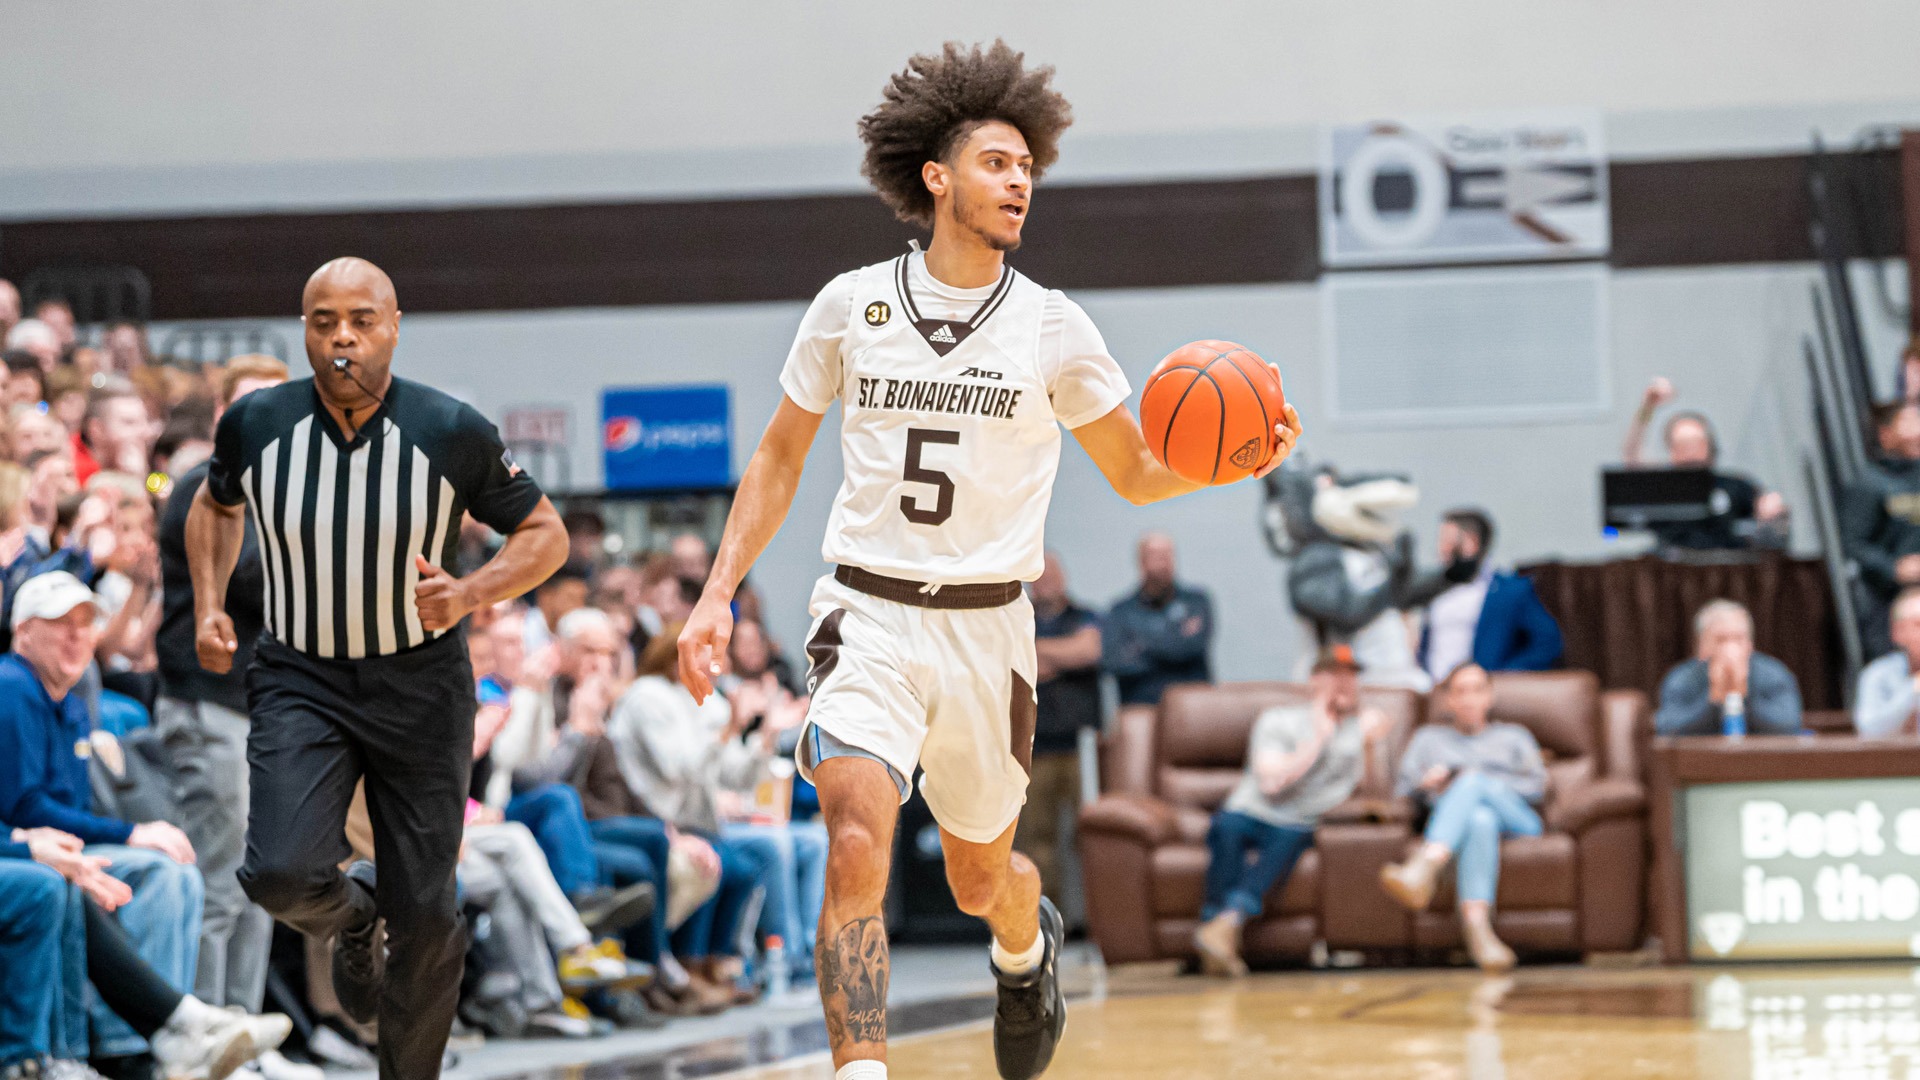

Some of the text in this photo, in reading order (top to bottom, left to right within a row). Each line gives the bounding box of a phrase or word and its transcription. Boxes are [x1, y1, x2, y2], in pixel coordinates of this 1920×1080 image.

[867, 305, 889, 323] 31
[929, 334, 957, 344] adidas
[957, 366, 1003, 380] A10
[858, 377, 1023, 420] ST. BONAVENTURE
[900, 427, 960, 526] 5
[1740, 799, 1886, 860] Bt
[1742, 864, 1804, 925] in
